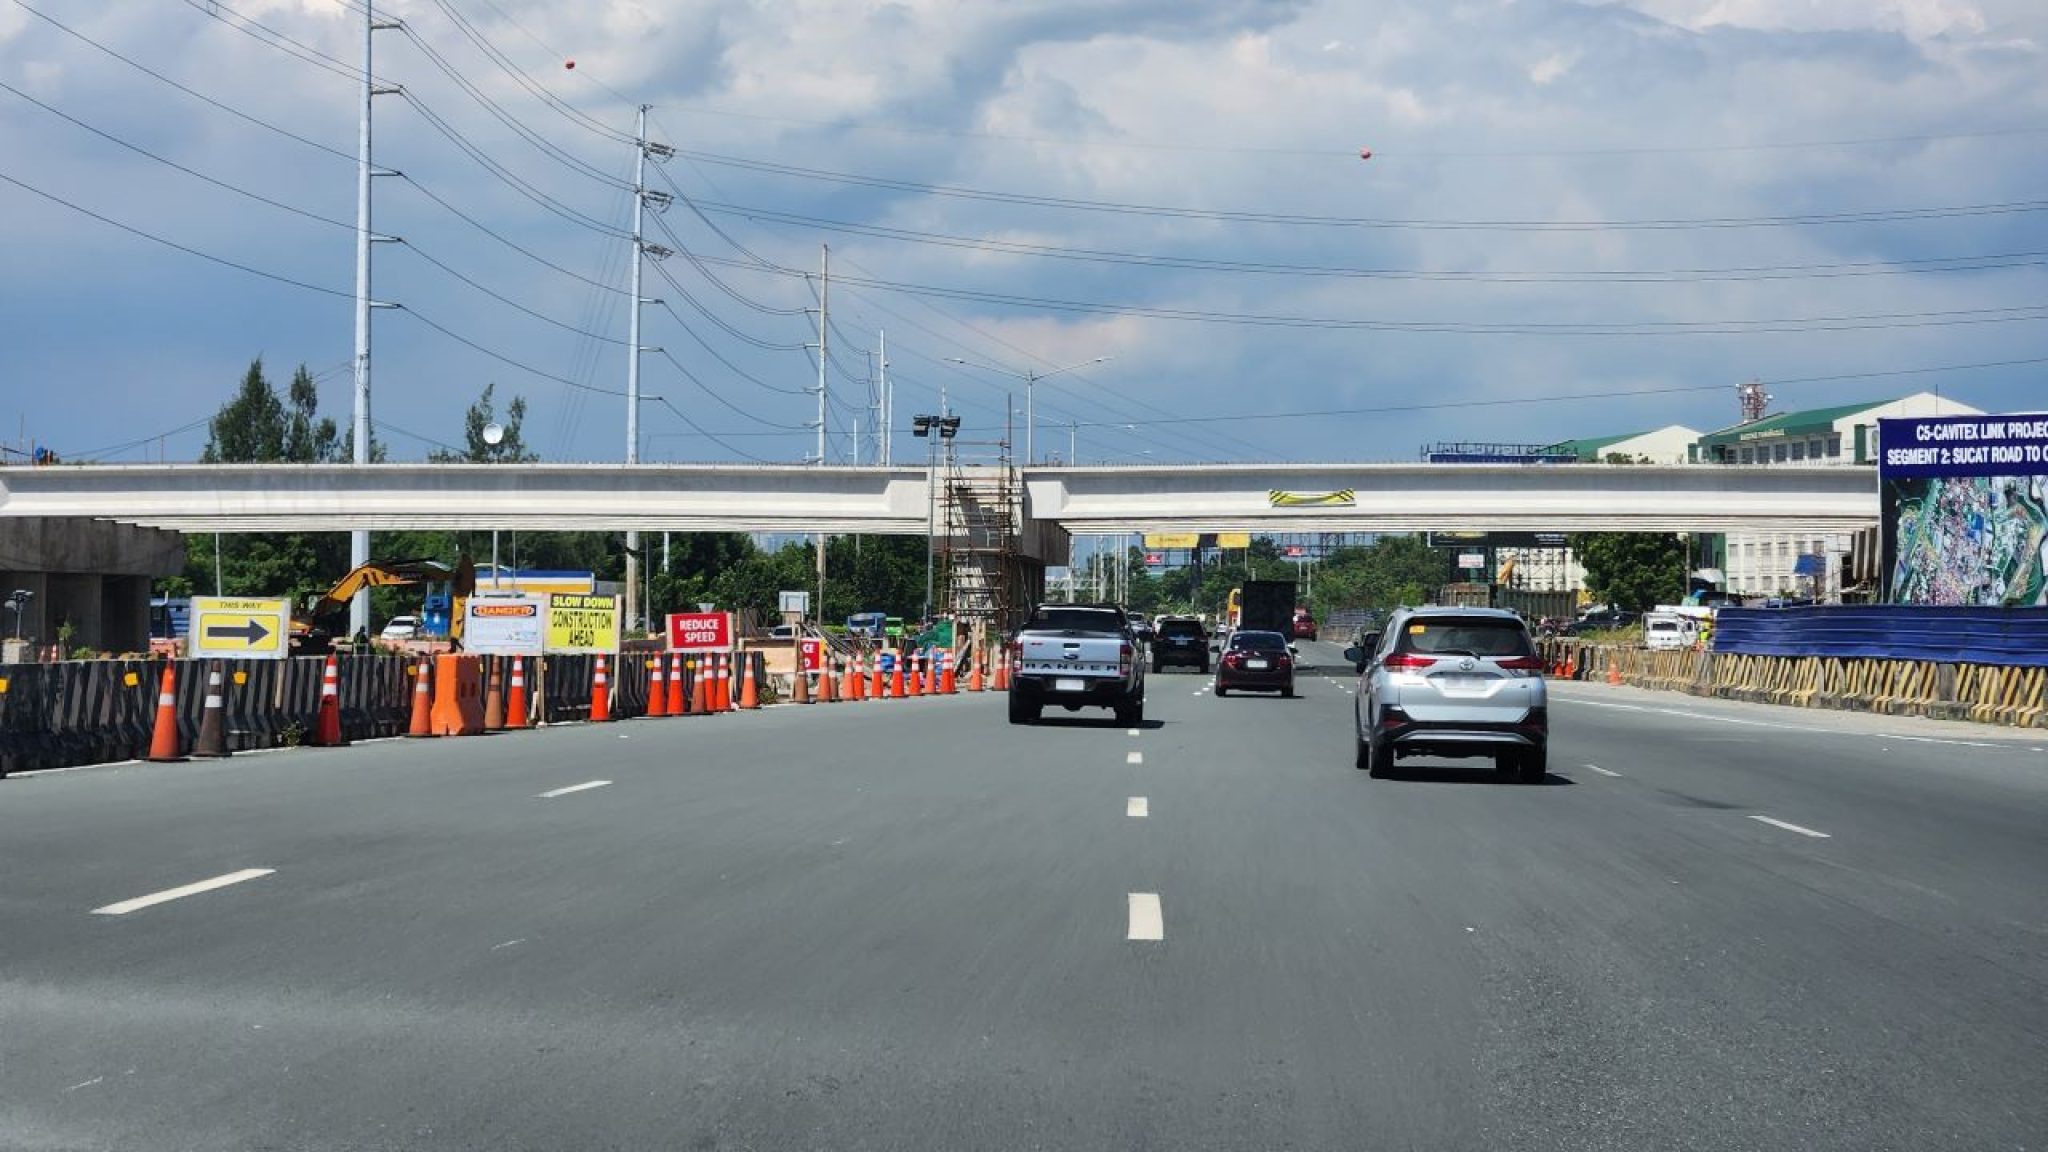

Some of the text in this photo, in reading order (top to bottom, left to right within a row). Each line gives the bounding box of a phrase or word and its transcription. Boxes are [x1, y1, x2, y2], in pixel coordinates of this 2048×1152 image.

[1916, 424, 1979, 440] C5-CAVITEX
[1980, 423, 2006, 439] LINK
[1887, 448, 1939, 465] SEGMENT
[1940, 449, 1950, 464] 2:
[1952, 447, 1990, 464] SUCAT
[1991, 446, 2023, 463] ROAD
[2023, 445, 2041, 462] TO
[219, 601, 262, 609] THIS WAY
[552, 596, 614, 608] SLOW DOWN
[552, 610, 612, 630] CONSTRUCTION
[679, 618, 720, 630] REDUCE
[568, 629, 594, 647] AHEAD
[684, 631, 716, 643] SPEED
[1025, 663, 1118, 671] RANGER
